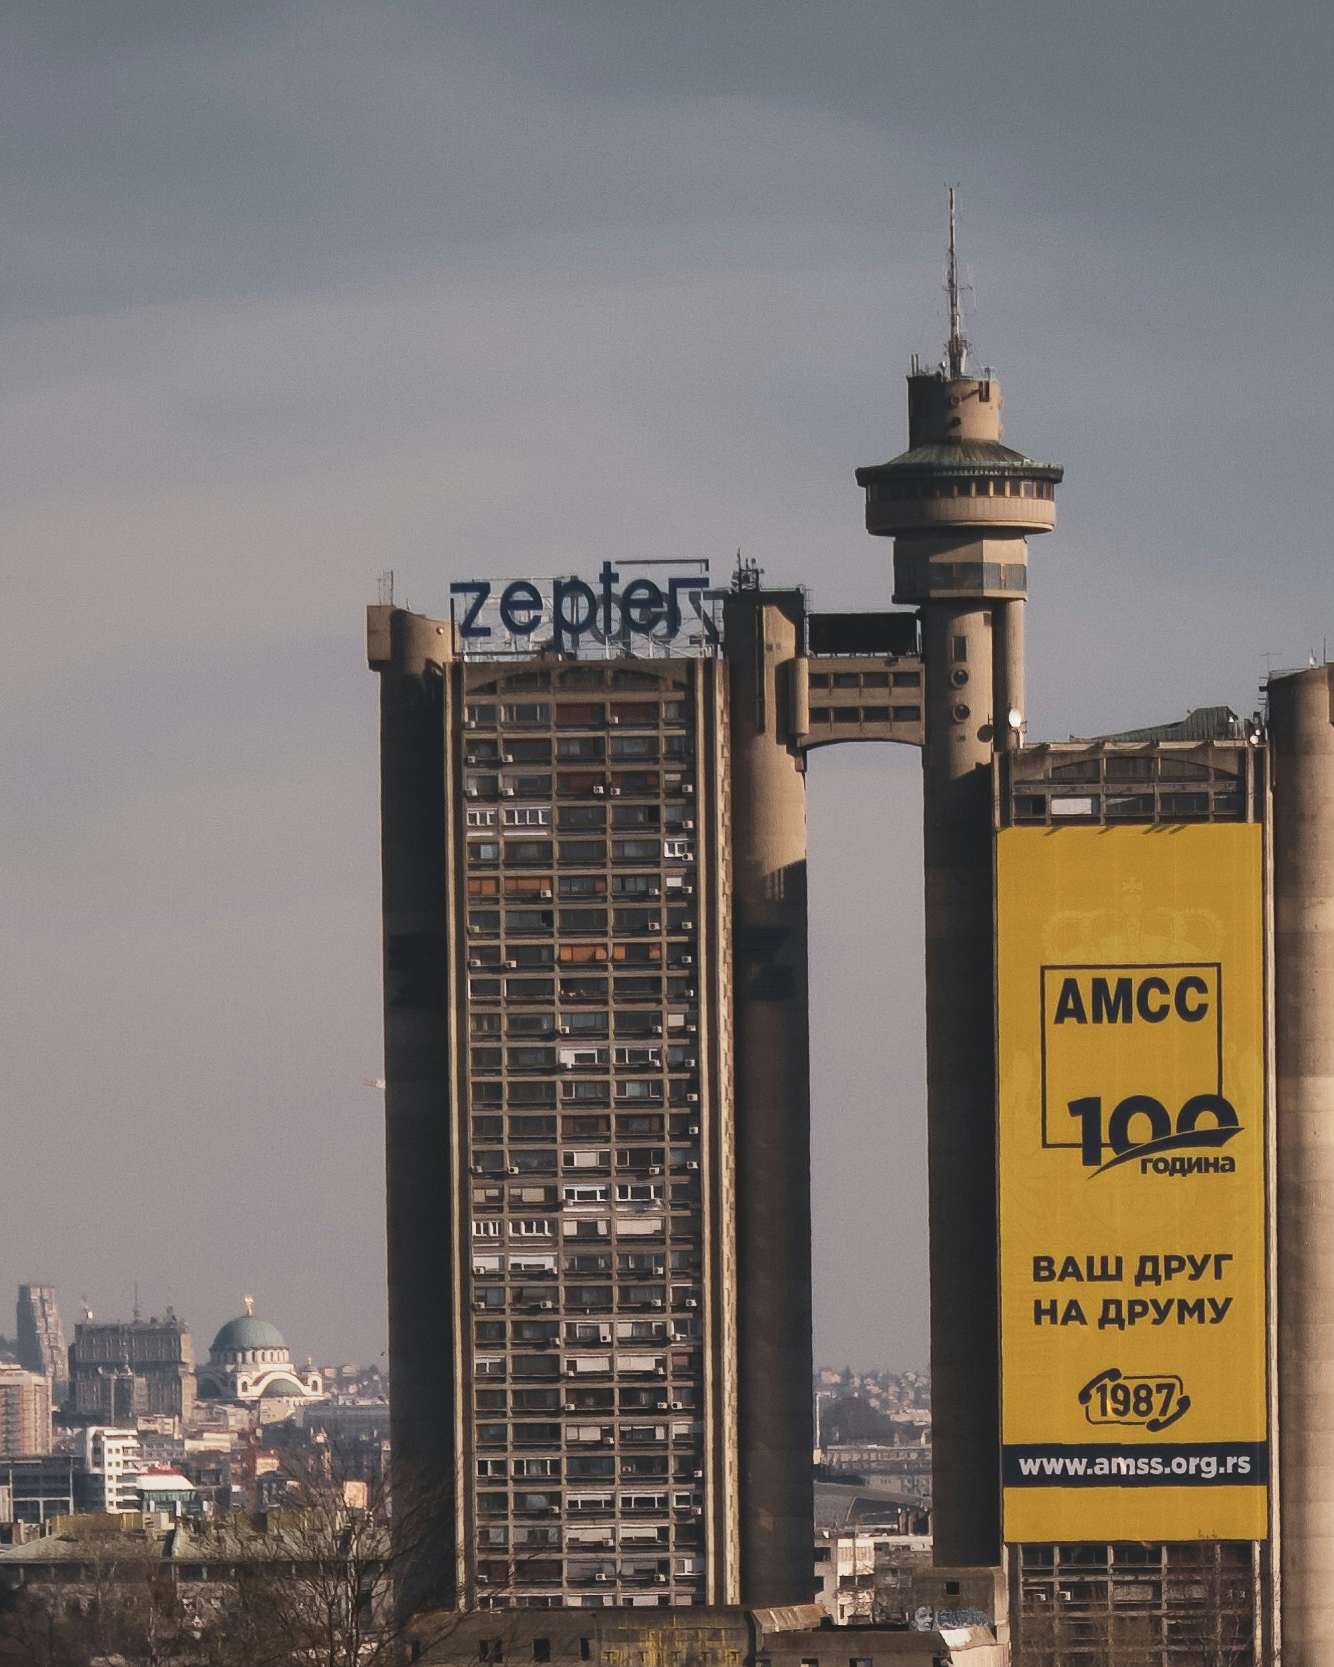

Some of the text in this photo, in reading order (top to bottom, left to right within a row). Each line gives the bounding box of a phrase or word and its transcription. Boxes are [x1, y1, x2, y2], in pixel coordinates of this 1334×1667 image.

[450, 561, 709, 654] zepter
[1053, 976, 1210, 1024] АМСС
[1067, 1094, 1239, 1167] 100
[1140, 1156, 1236, 1177] година
[1032, 1253, 1234, 1287] ВАШ ДРУГ
[1034, 1297, 1234, 1331] НА ДРУМУ
[1095, 1383, 1176, 1418] 1987
[1018, 1455, 1252, 1478] www.amss.org.rs
